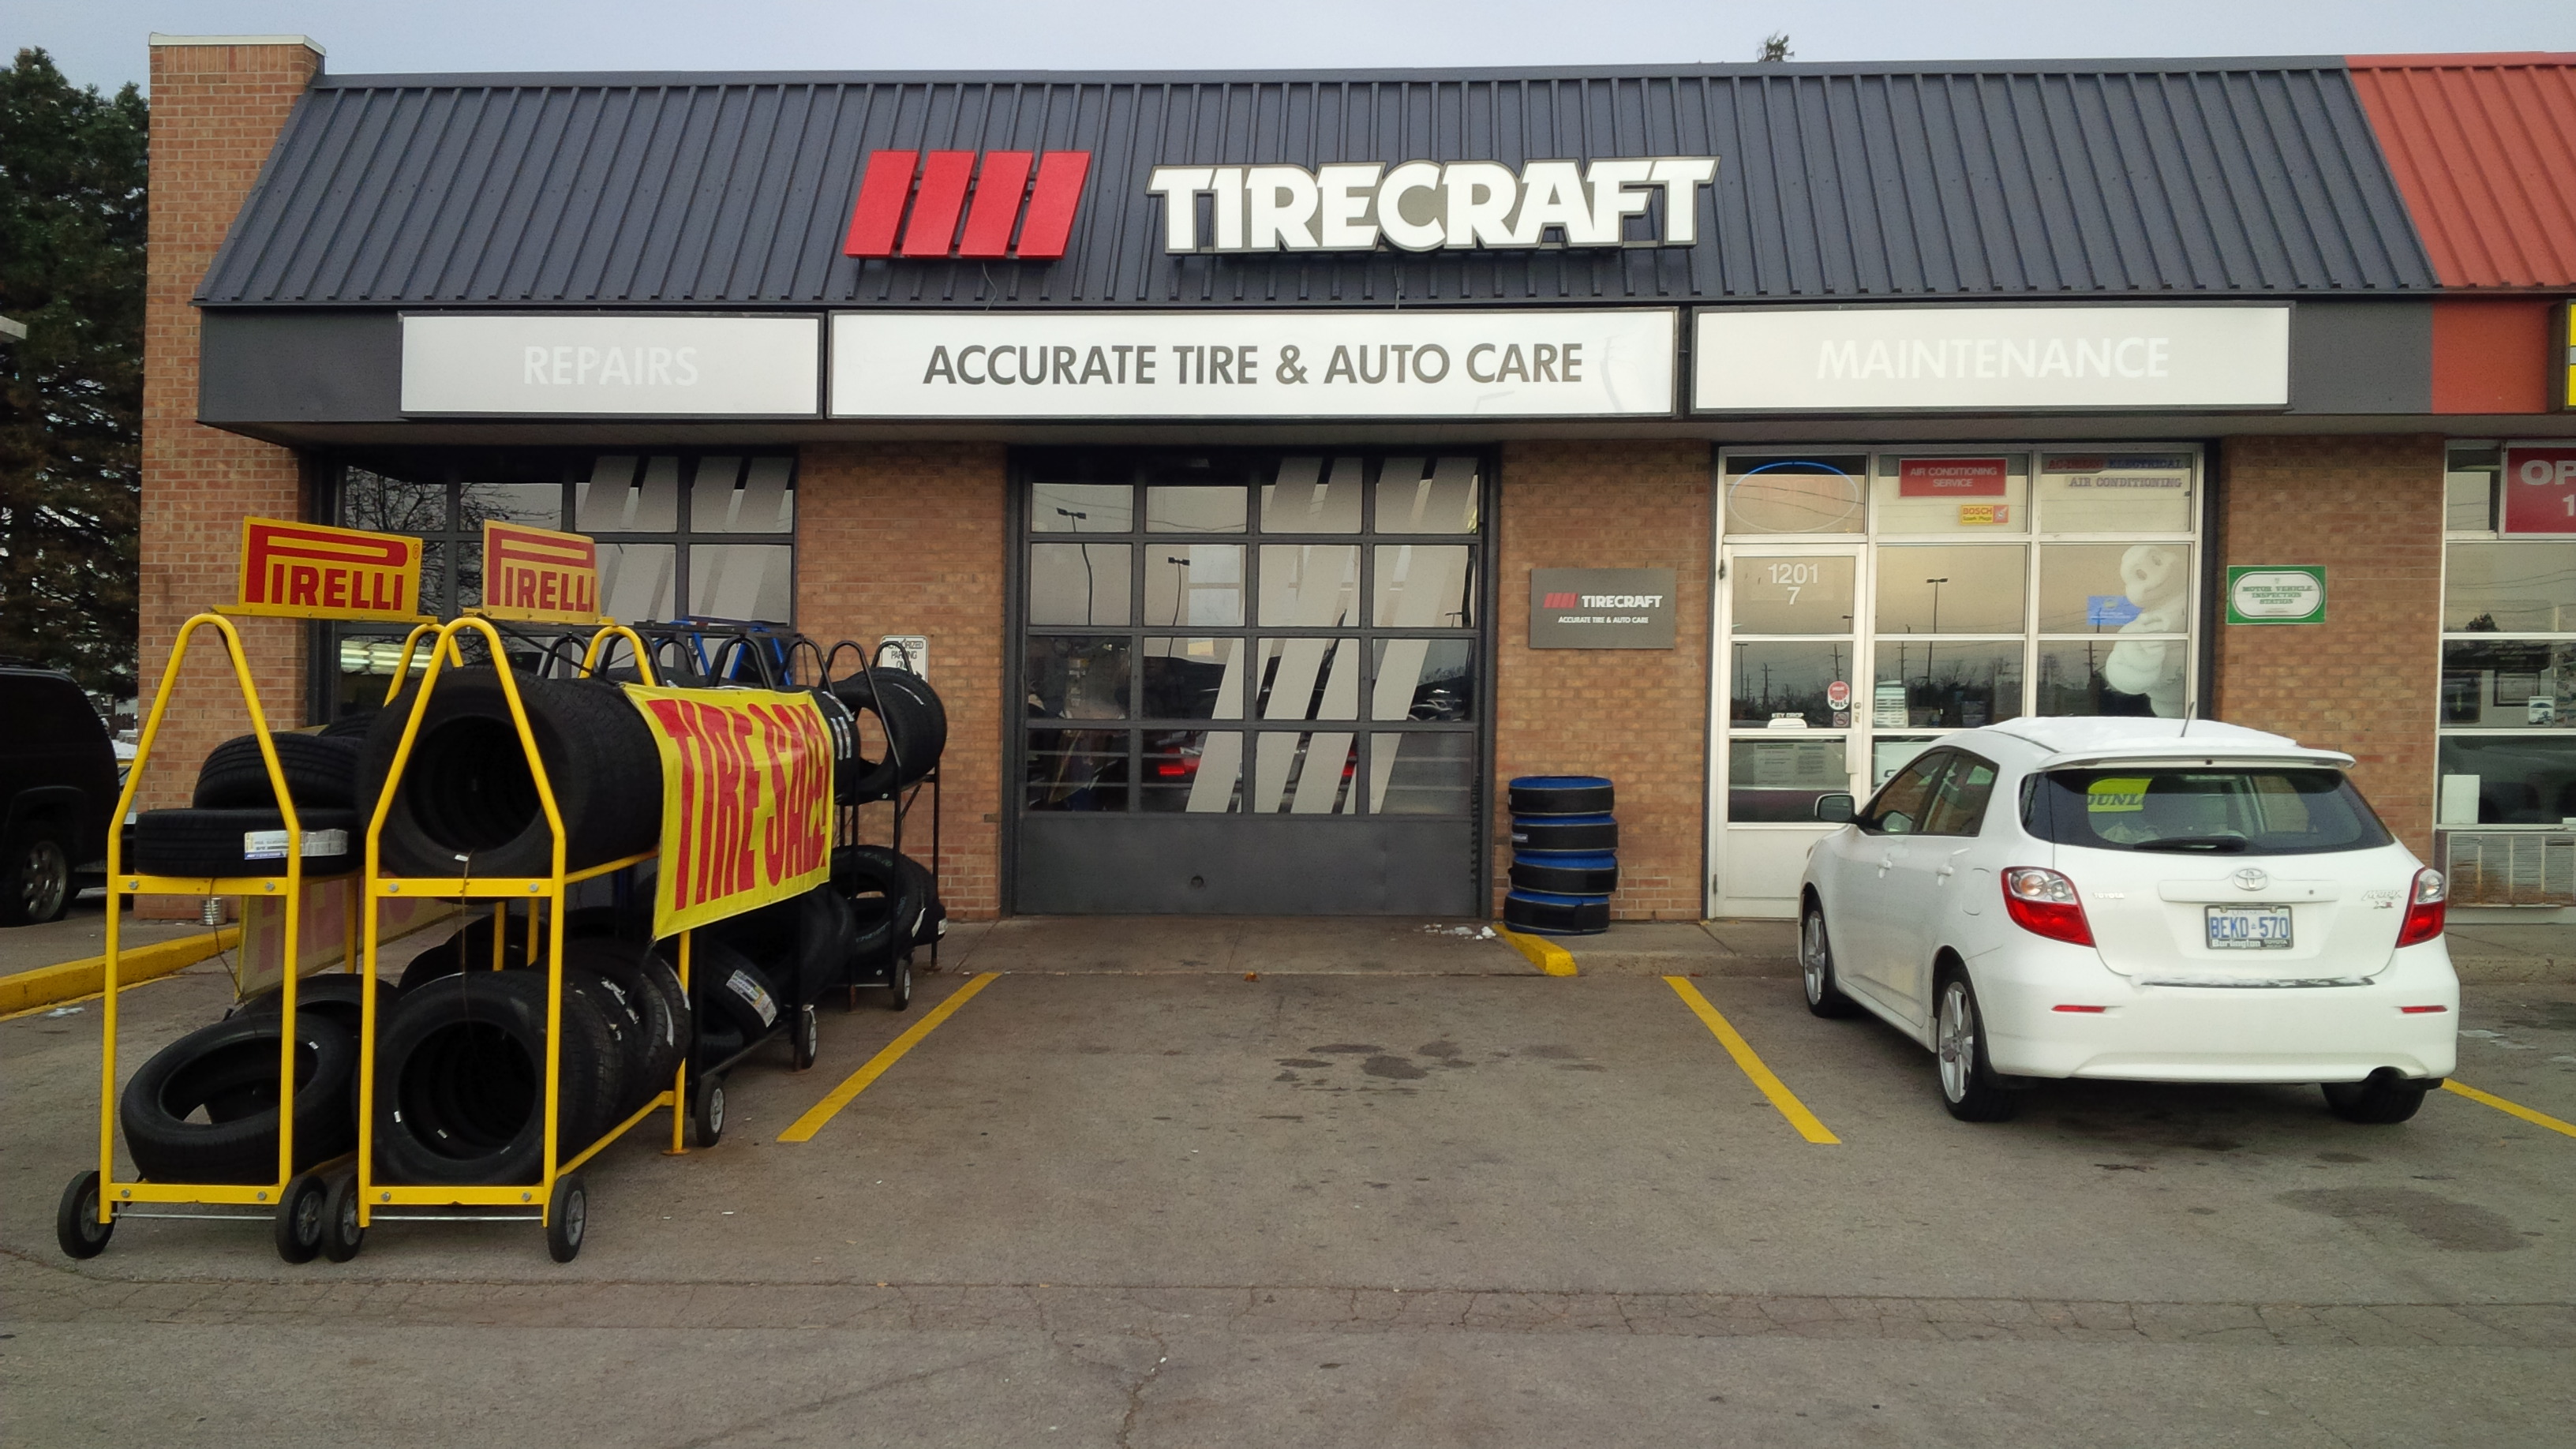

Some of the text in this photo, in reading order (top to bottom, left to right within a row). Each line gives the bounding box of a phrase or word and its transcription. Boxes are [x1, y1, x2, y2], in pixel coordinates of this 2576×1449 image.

[1147, 157, 1719, 253] TIRECRAFT
[522, 345, 699, 386] REPAIRS
[923, 343, 1582, 386] ACCURATE TIRE & AUTO CARE
[1817, 337, 2170, 379] MAINTENANCE
[1910, 466, 1998, 476] AIR CONDITIONING
[1933, 478, 1973, 487] SERVICE
[2069, 477, 2183, 488] AIR CONDITIONING
[245, 524, 407, 611] PIRELLI
[487, 528, 595, 612] PIRELLI
[1768, 563, 1818, 584] 1201
[1582, 595, 1663, 608] TIRECRAFT
[1787, 586, 1801, 605] 7
[646, 698, 756, 912] TIRE
[2087, 793, 2141, 806] DUNL
